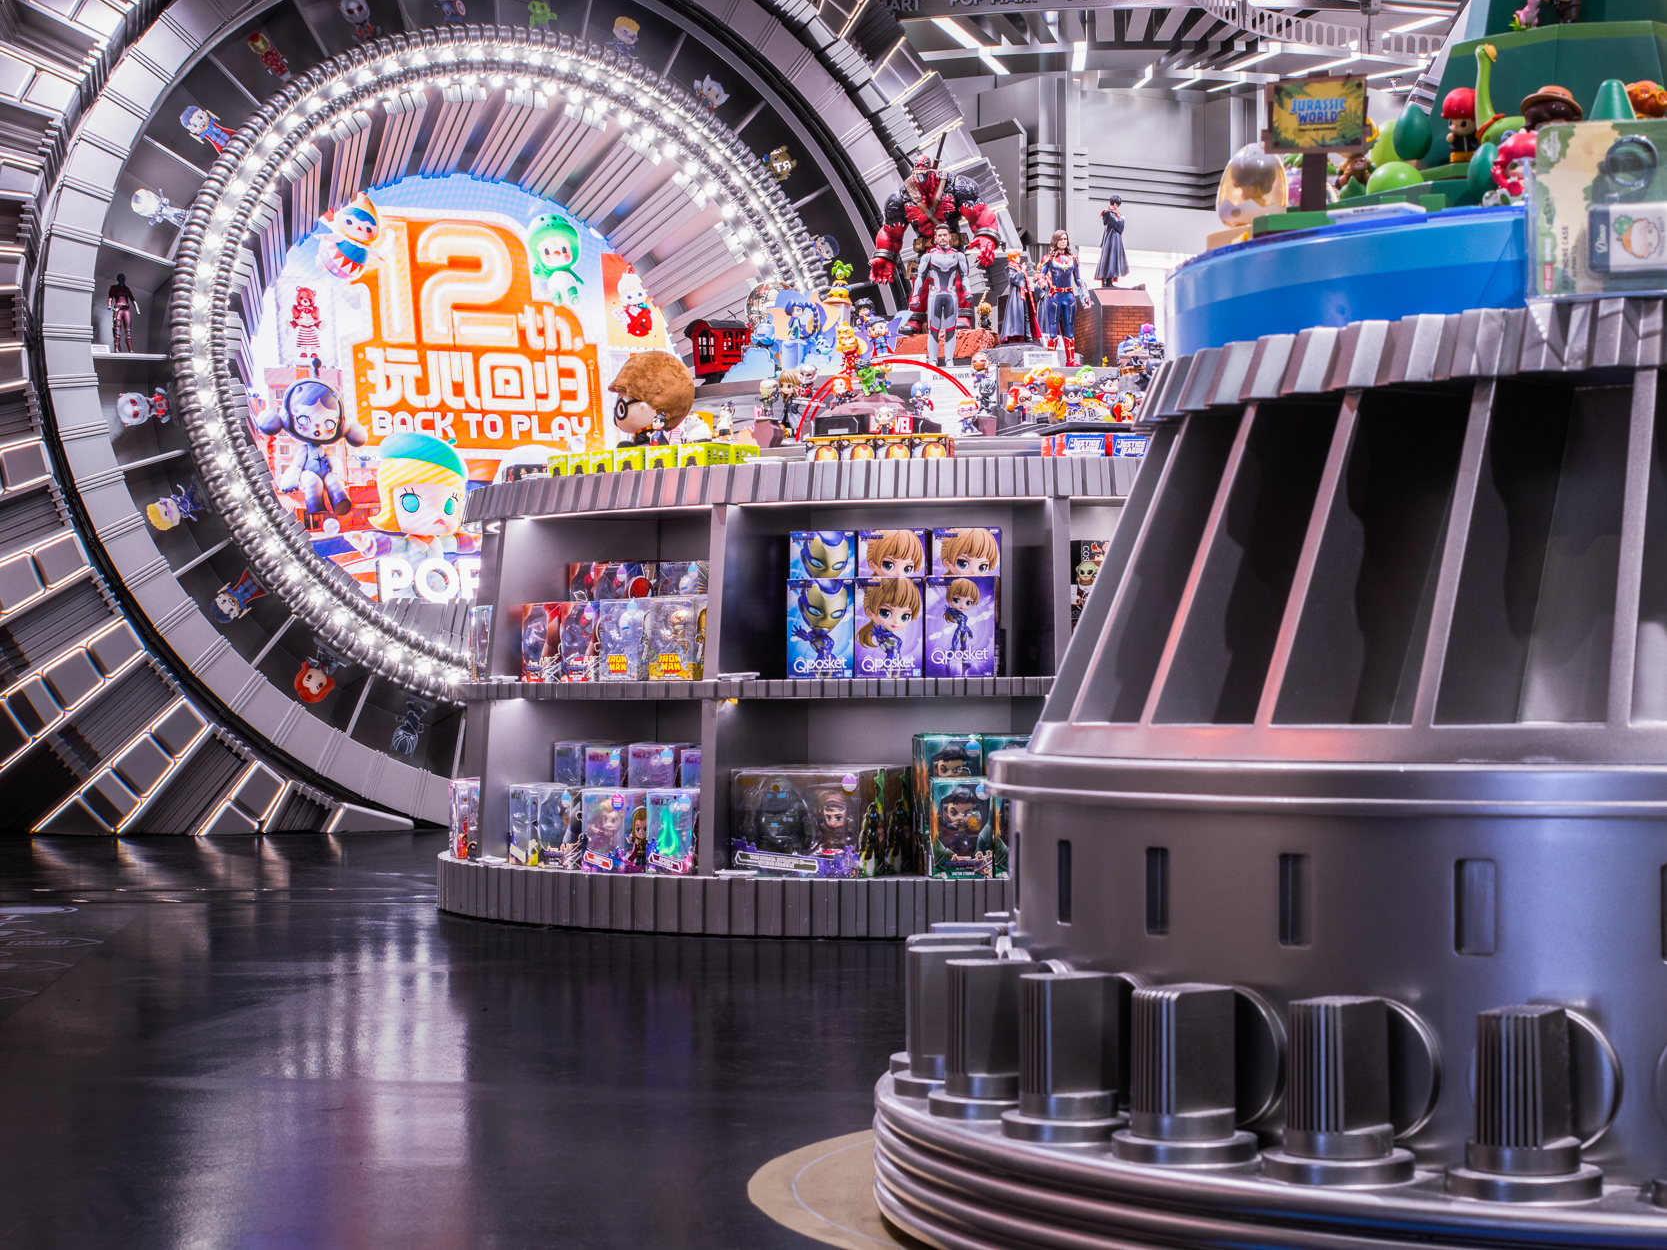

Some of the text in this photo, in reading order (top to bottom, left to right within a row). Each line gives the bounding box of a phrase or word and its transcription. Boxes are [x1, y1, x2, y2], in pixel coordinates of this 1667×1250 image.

[1290, 97, 1346, 114] JURASSIC
[1298, 111, 1338, 125] WORLD
[371, 410, 591, 441] BACK TO PLAY
[608, 655, 628, 663] IRON
[931, 645, 988, 665] Qposket
[609, 663, 627, 671] MAN
[662, 662, 681, 671] MAN
[793, 655, 847, 674] Qposket
[861, 655, 915, 674] Qposket
